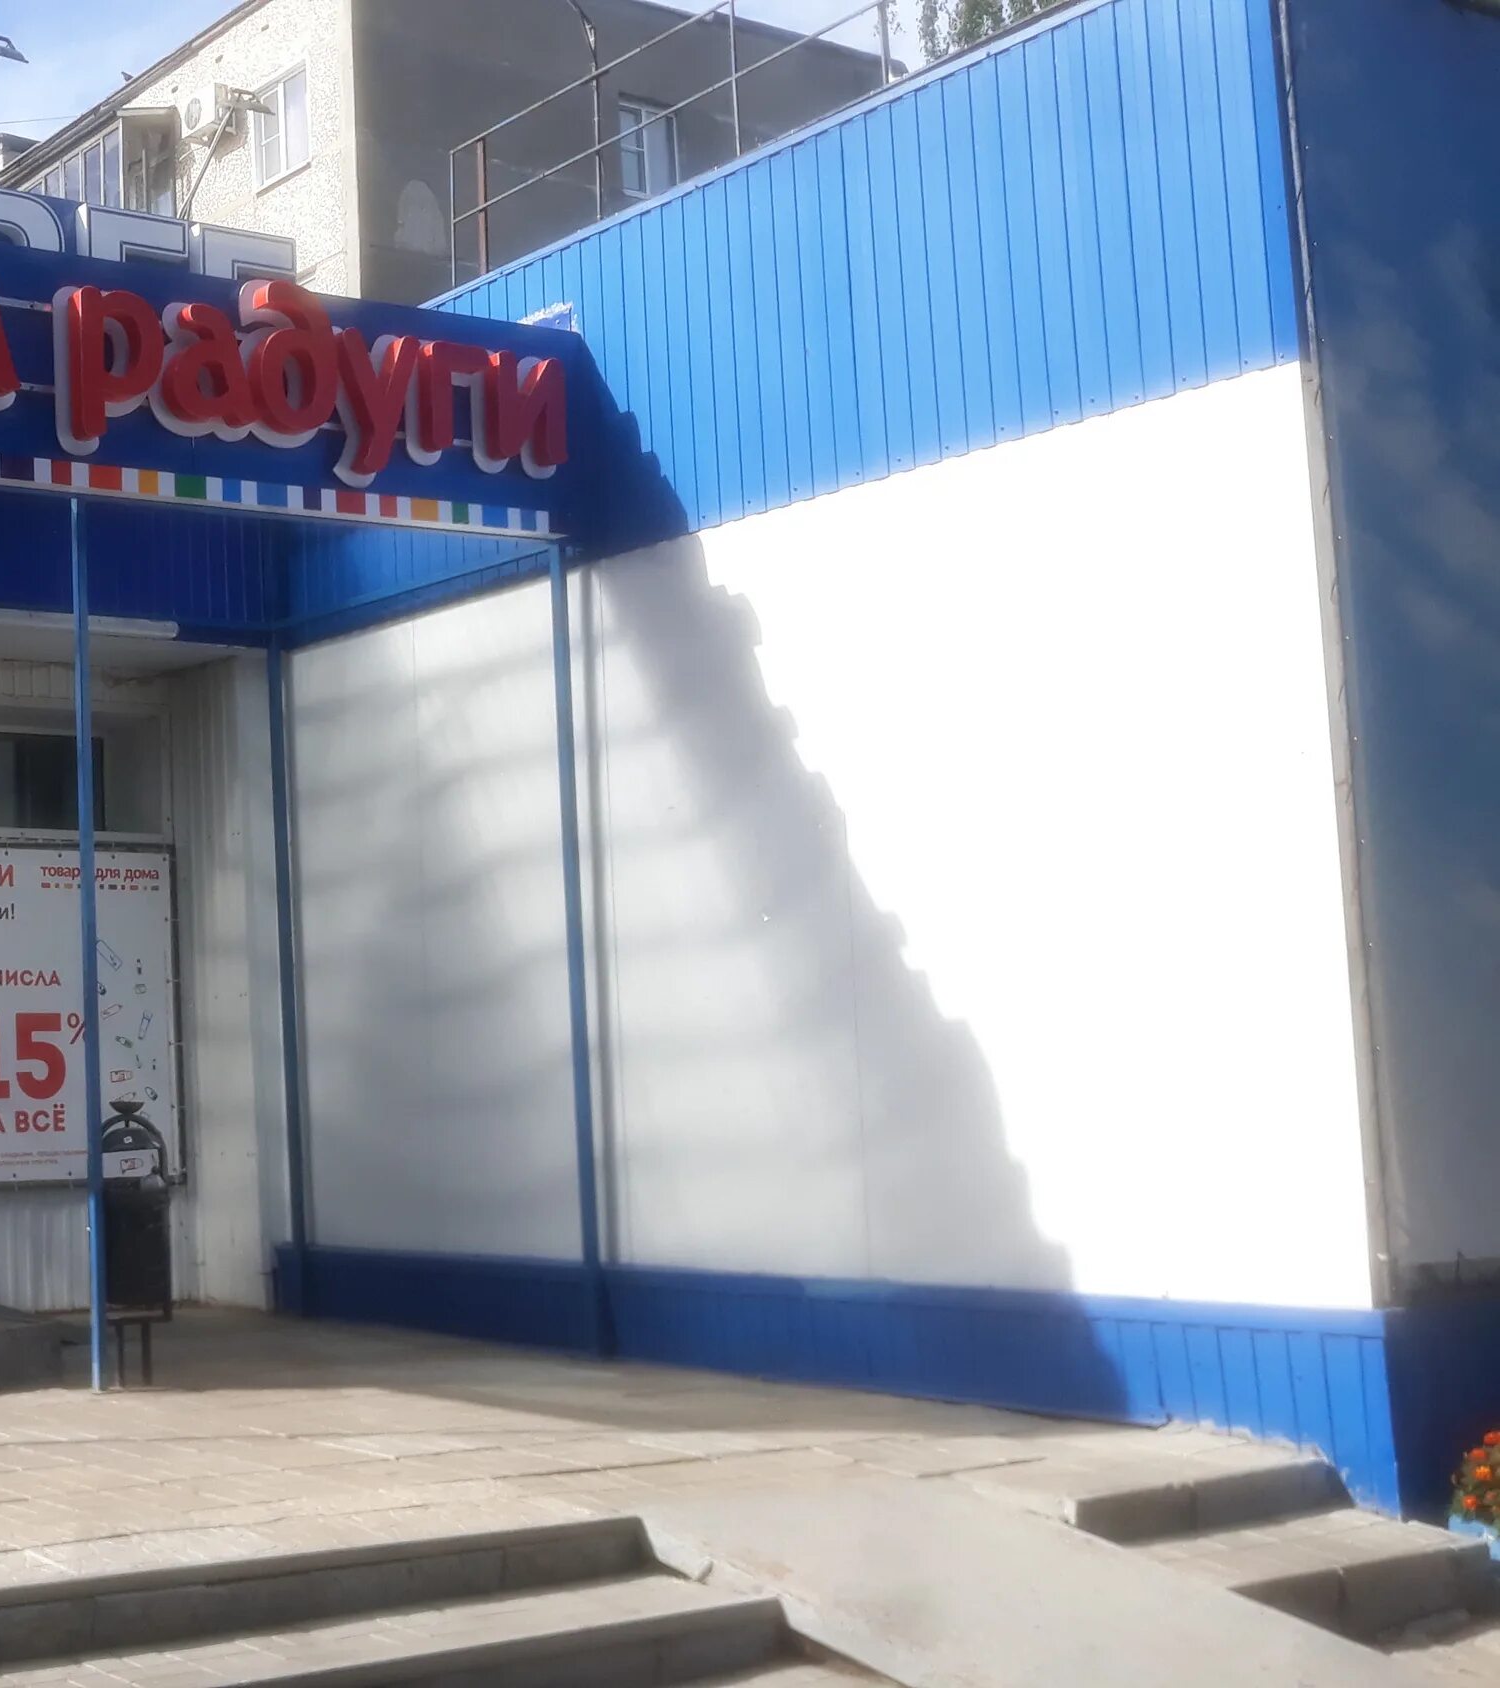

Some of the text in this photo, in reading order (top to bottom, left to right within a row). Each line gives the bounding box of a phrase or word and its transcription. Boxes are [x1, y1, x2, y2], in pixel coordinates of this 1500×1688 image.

[54, 279, 566, 488] радуги
[40, 865, 160, 882] товар для дома
[14, 1104, 66, 1133] ВСЁ
